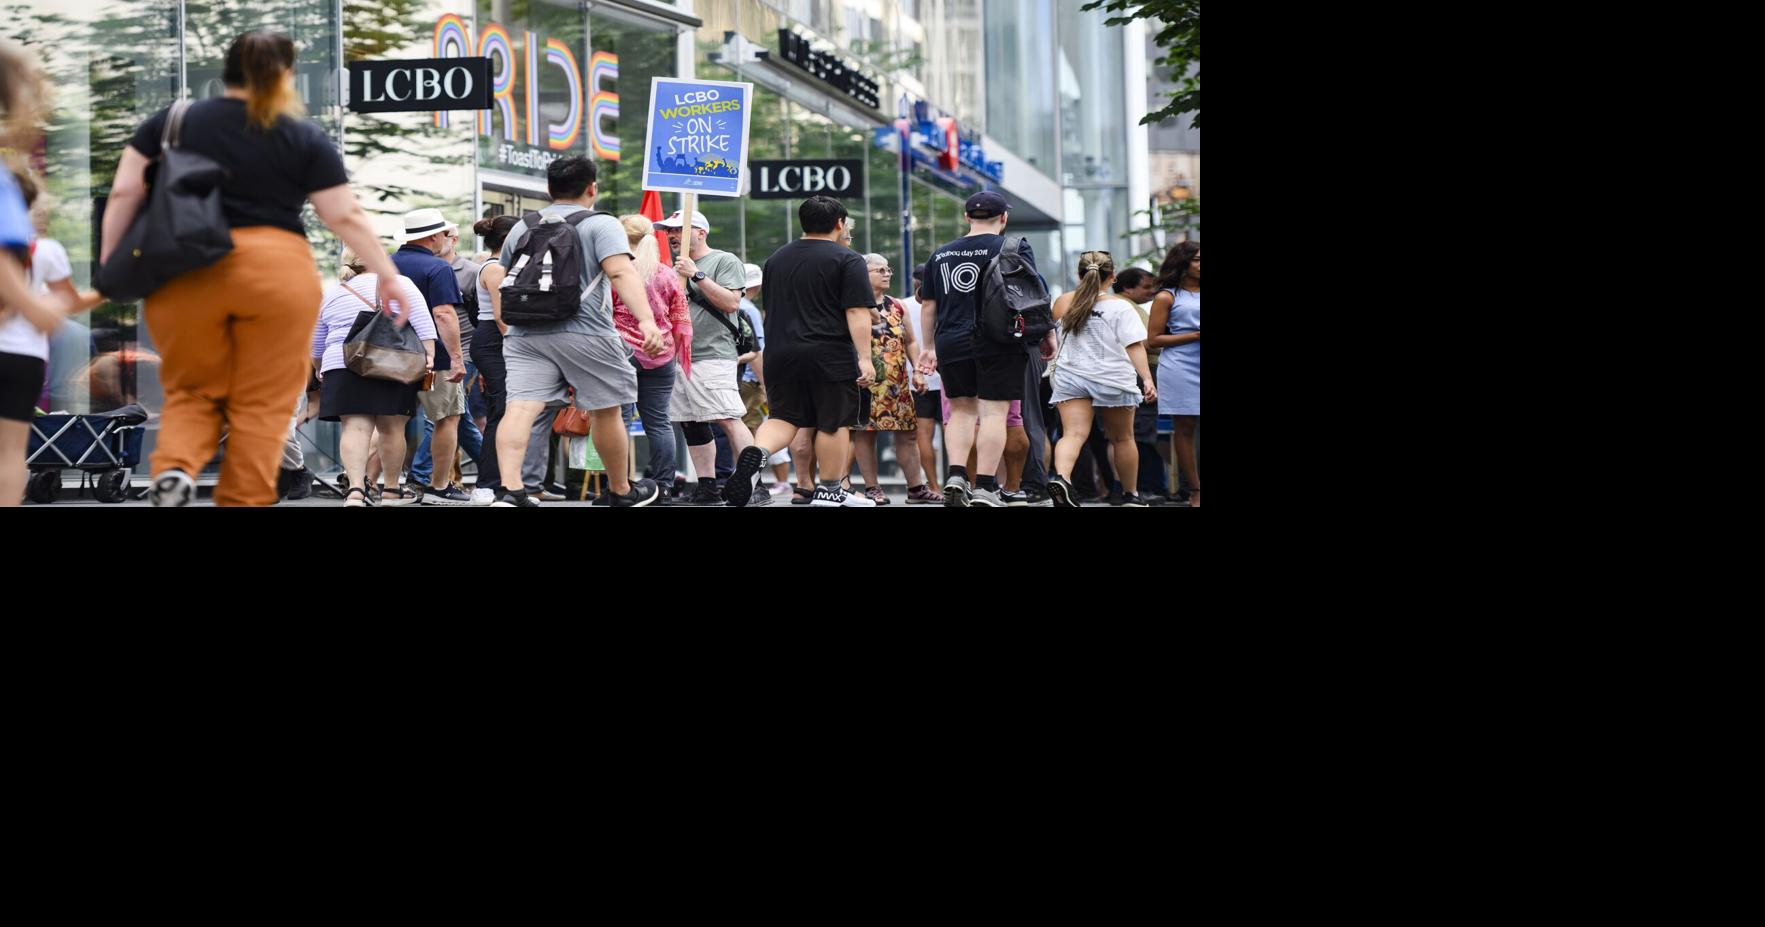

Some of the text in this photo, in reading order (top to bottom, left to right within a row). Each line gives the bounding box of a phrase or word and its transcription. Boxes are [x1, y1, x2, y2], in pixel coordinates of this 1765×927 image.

[362, 66, 473, 102] LCBO
[674, 89, 719, 105] LCBO
[659, 99, 740, 120] WORKERS
[687, 116, 712, 134] ON
[667, 134, 730, 155] STRIKE
[760, 165, 851, 192] LCBO
[817, 492, 842, 502] MAX
